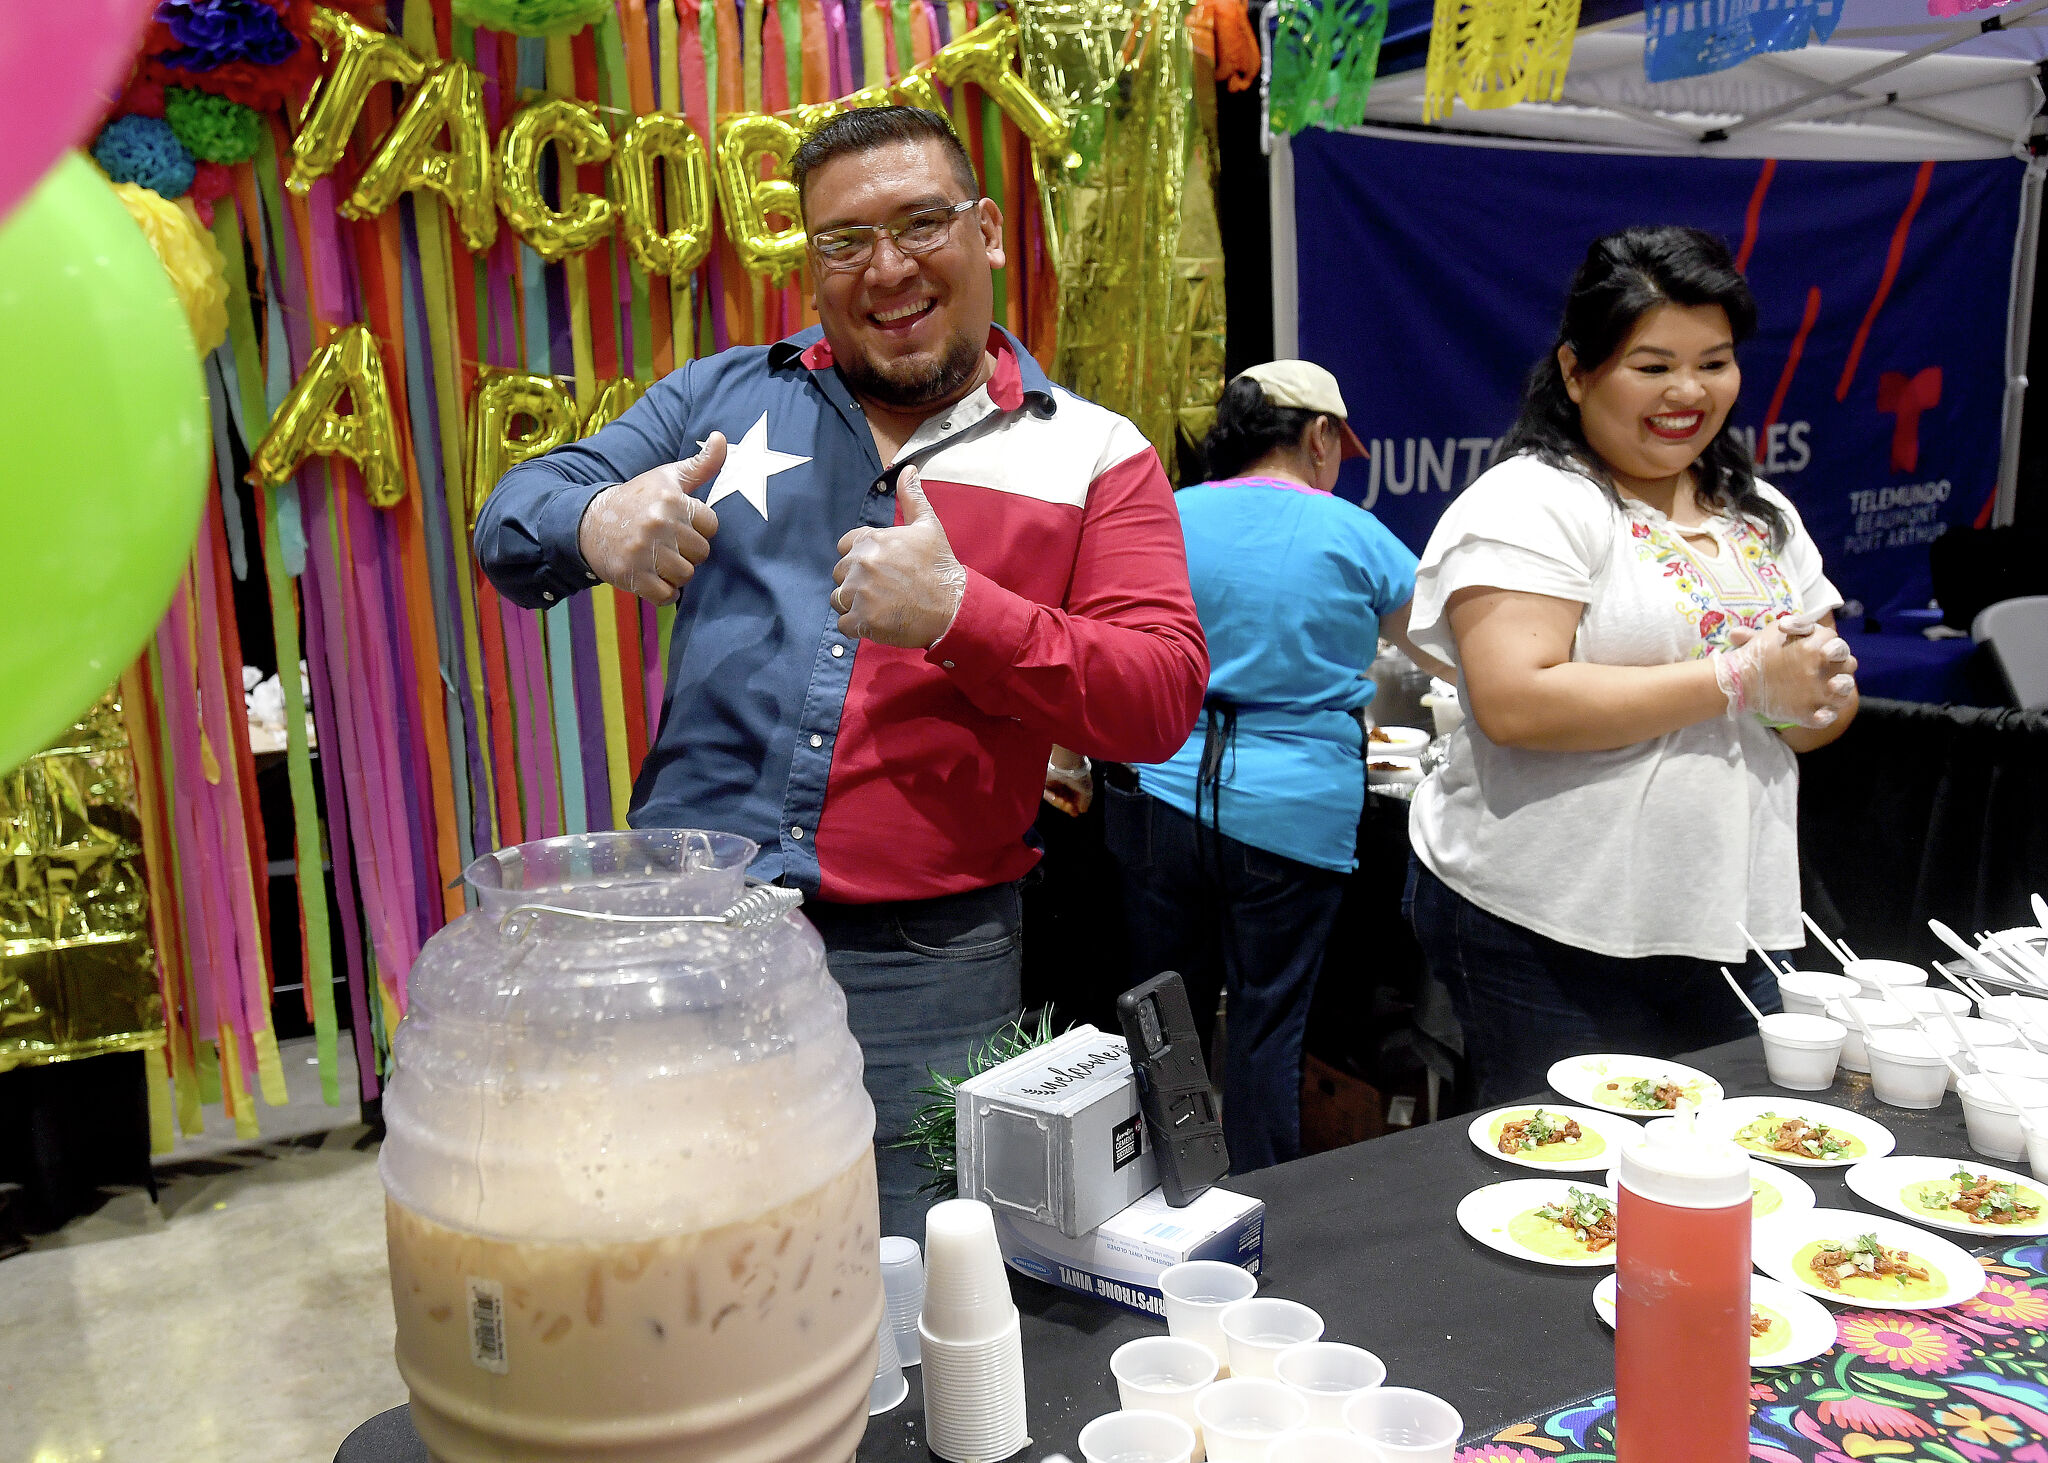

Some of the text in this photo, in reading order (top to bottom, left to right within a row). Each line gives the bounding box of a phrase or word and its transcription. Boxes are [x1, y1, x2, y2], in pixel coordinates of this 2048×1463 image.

[285, 6, 1076, 285] TACOBT
[245, 323, 405, 507] A
[1363, 436, 1503, 510] JUNT
[1849, 479, 1951, 515] TELEMUNDO
[1040, 1049, 1121, 1091] welcome
[1115, 1132, 1135, 1150] CEMENT
[1144, 1254, 1175, 1268] NDUSTRIAL
[1058, 1266, 1168, 1317] RIPSTRONG VINYL
